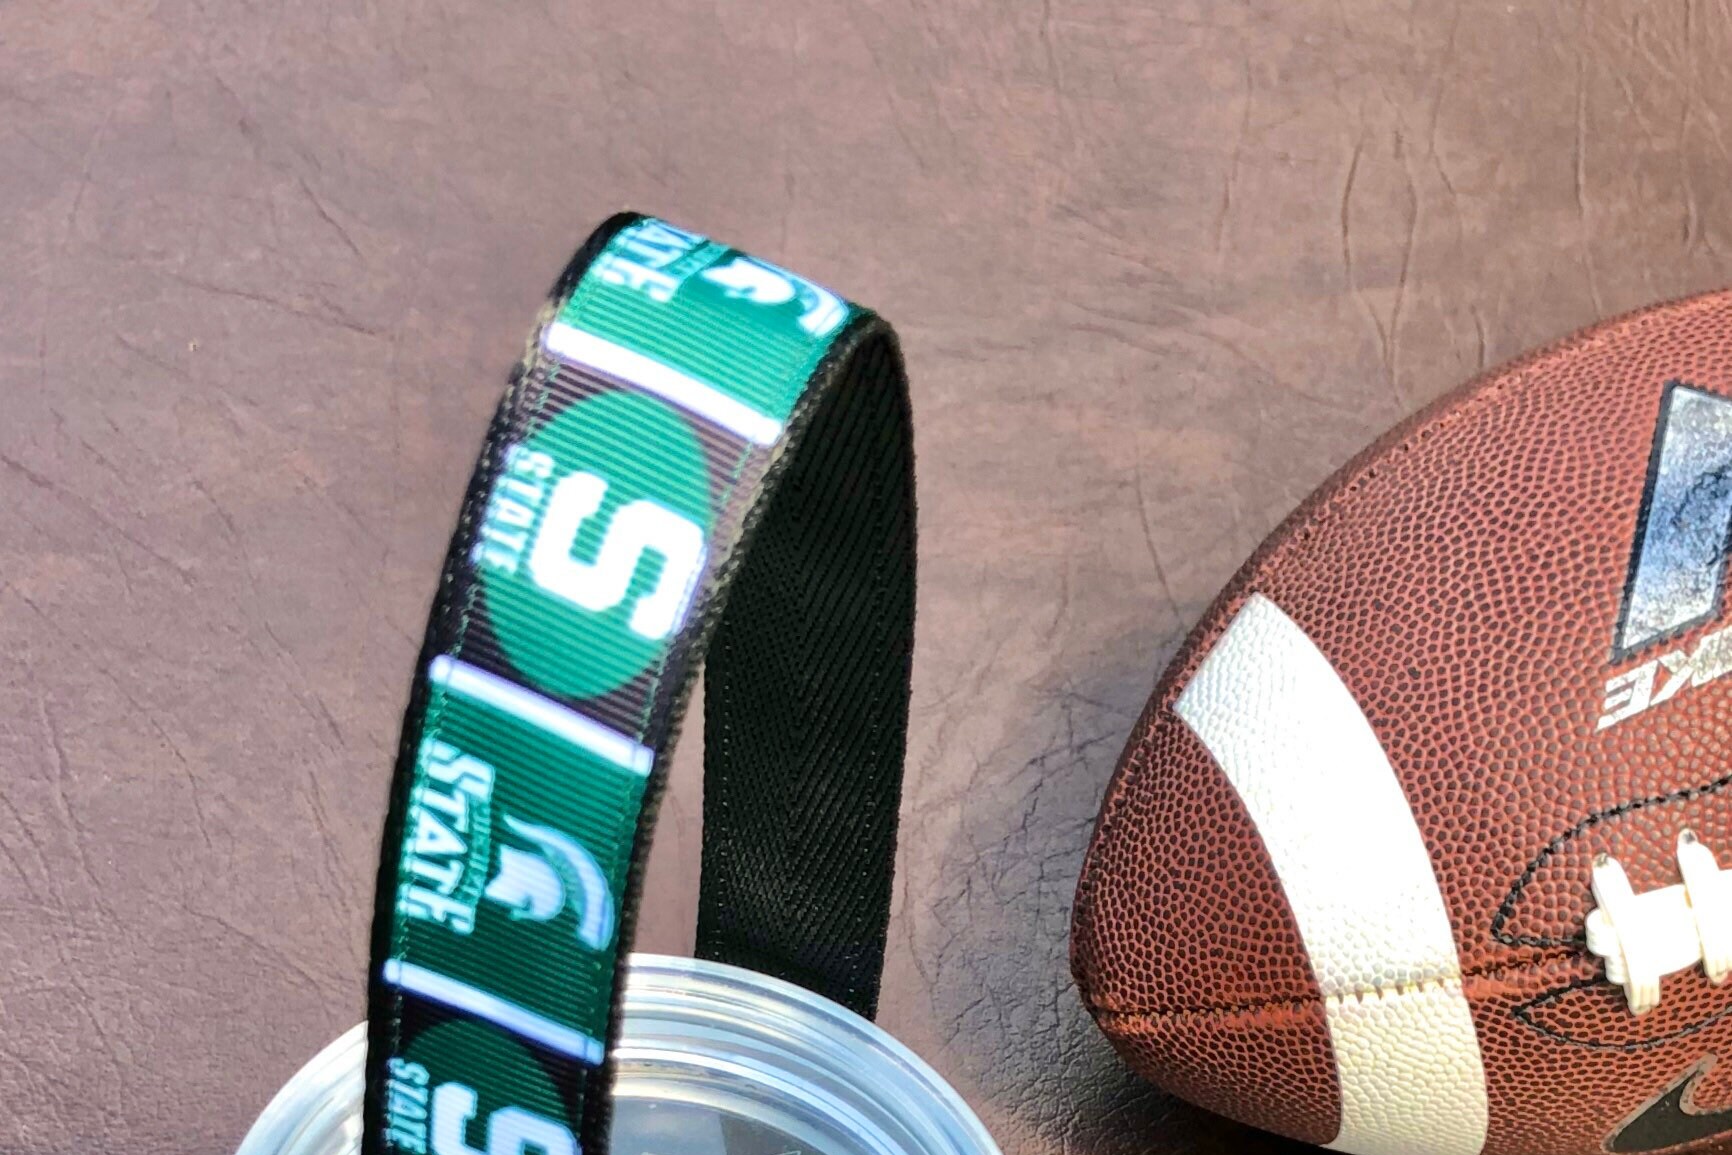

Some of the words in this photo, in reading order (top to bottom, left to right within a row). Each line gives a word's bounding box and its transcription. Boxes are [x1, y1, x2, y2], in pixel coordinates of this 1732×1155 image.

[472, 445, 556, 573] STATE
[527, 469, 707, 640] S
[401, 738, 496, 935] STATE
[387, 1058, 430, 1155] STATE
